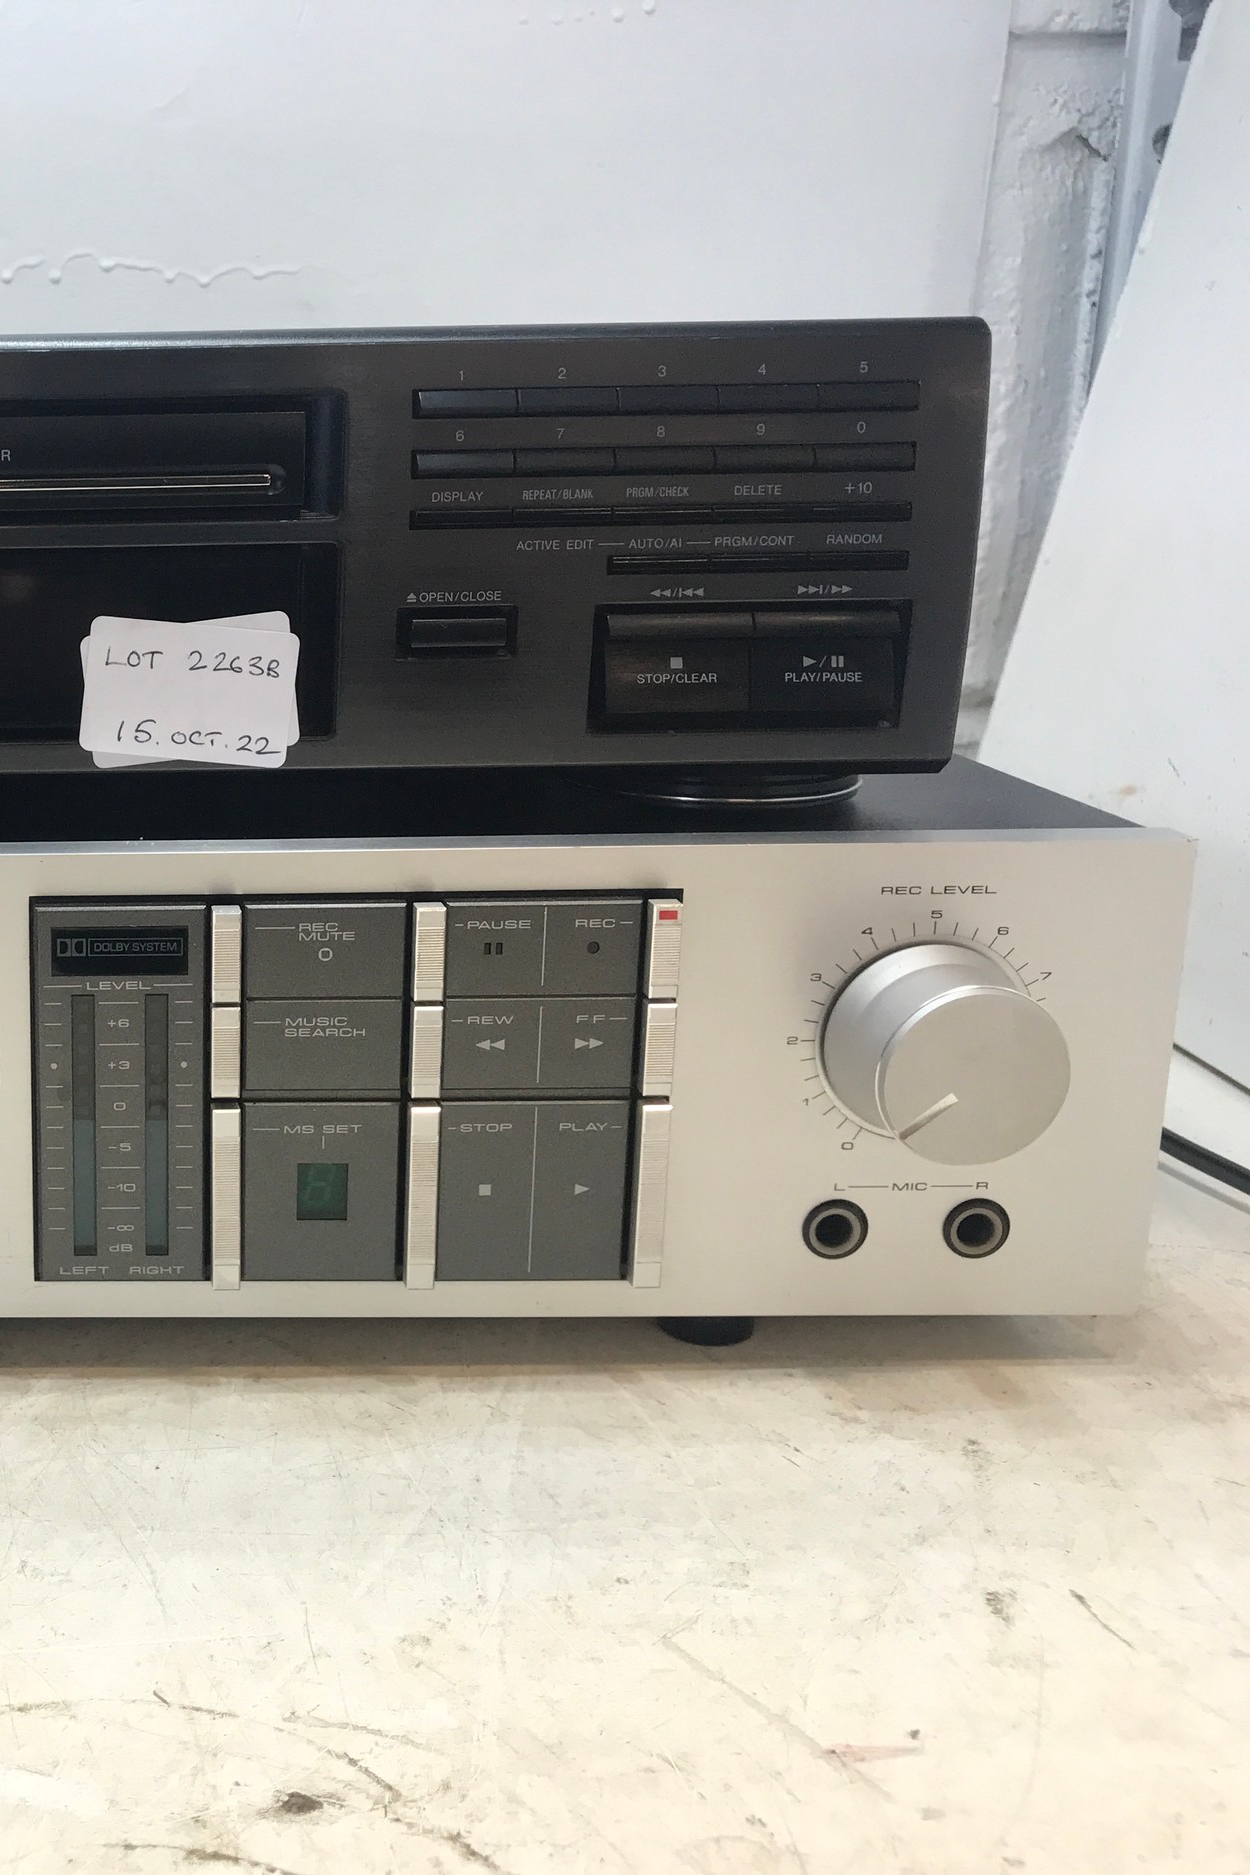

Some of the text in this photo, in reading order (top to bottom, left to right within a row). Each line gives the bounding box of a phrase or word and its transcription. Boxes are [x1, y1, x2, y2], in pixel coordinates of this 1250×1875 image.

[657, 364, 667, 378] 3
[757, 363, 767, 375] 4
[859, 360, 869, 374] 5
[458, 369, 464, 382] 1
[557, 366, 567, 380] 2
[656, 425, 666, 438] 8
[756, 423, 766, 436] 9
[856, 421, 867, 434] 0
[455, 429, 465, 442] 6
[556, 427, 565, 440] 7
[625, 486, 689, 498] PRGM/CHECK
[733, 484, 782, 496] DELETE
[844, 481, 873, 494] +10
[431, 491, 484, 503] DISPLAY
[522, 488, 594, 501] REPEAT/BLANK
[516, 535, 795, 551] ACTIVE EDIT AUTO/AI PRGM/CONT
[826, 533, 883, 545] RANDOM
[418, 590, 502, 603] OPEN/CLOSE
[104, 645, 165, 671] LOT
[636, 672, 718, 685] STOP/CLEAR
[784, 671, 862, 683] PLAY/PAUSE
[880, 885, 996, 896] REC LEVEL
[930, 909, 943, 920] 5
[298, 922, 339, 932] REC
[466, 919, 531, 930] PAUSE
[574, 918, 616, 929] REC
[861, 926, 873, 936] 4
[996, 926, 1009, 936] 6
[297, 932, 356, 942] MUTE
[93, 941, 178, 953] DOLBY SYSTEM
[810, 972, 822, 982] 3
[1039, 971, 1052, 981] 7
[86, 980, 151, 991] LEVEL
[107, 1018, 130, 1028] +6
[284, 1016, 348, 1026] MUSIC
[467, 1015, 514, 1025] REW
[284, 1028, 367, 1038] SEARCH
[786, 1036, 799, 1046] 2
[107, 1060, 131, 1070] +3
[113, 1101, 127, 1111] 0
[802, 1097, 810, 1108] 1
[283, 1124, 362, 1135] MS SET
[459, 1122, 513, 1133] STOP
[559, 1122, 608, 1132] PLAY
[108, 1142, 132, 1152] -5
[840, 1141, 854, 1151] 0
[107, 1183, 137, 1193] -10
[833, 1181, 989, 1192] L MIC R
[108, 1243, 134, 1253] dB
[59, 1265, 110, 1275] LEFT
[129, 1265, 184, 1275] RIGHT
